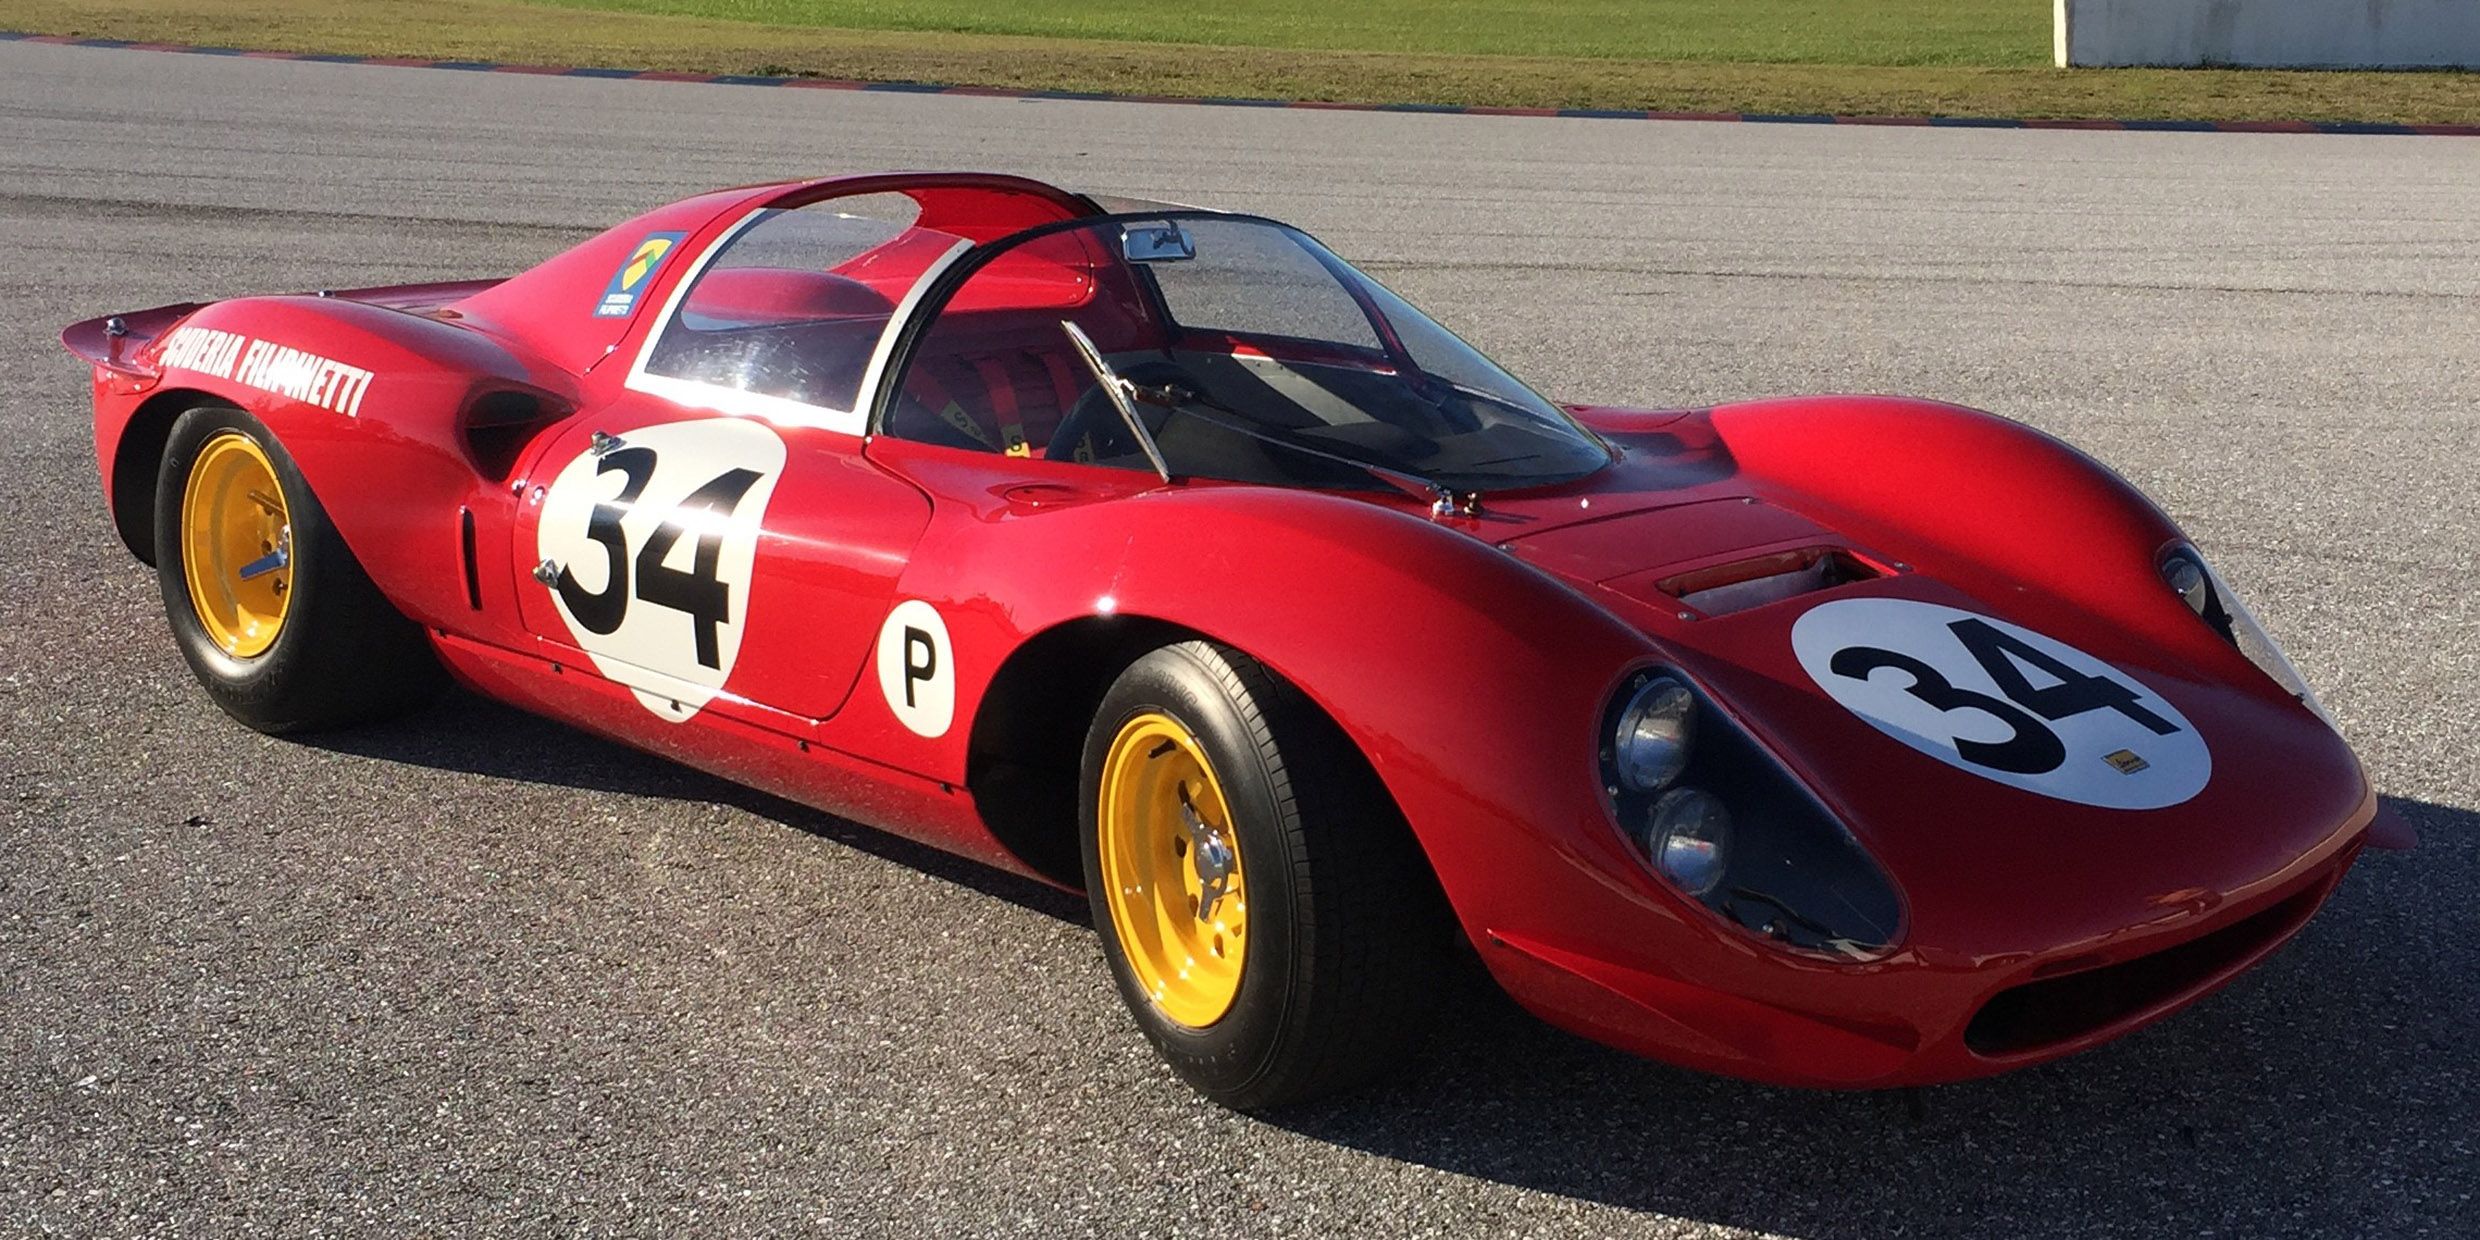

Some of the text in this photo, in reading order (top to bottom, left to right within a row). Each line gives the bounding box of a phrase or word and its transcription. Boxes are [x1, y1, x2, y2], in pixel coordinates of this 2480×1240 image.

[158, 327, 247, 380] SCUDERIA
[558, 446, 766, 671] 34
[904, 625, 936, 709] P
[1830, 618, 2182, 775] 34
